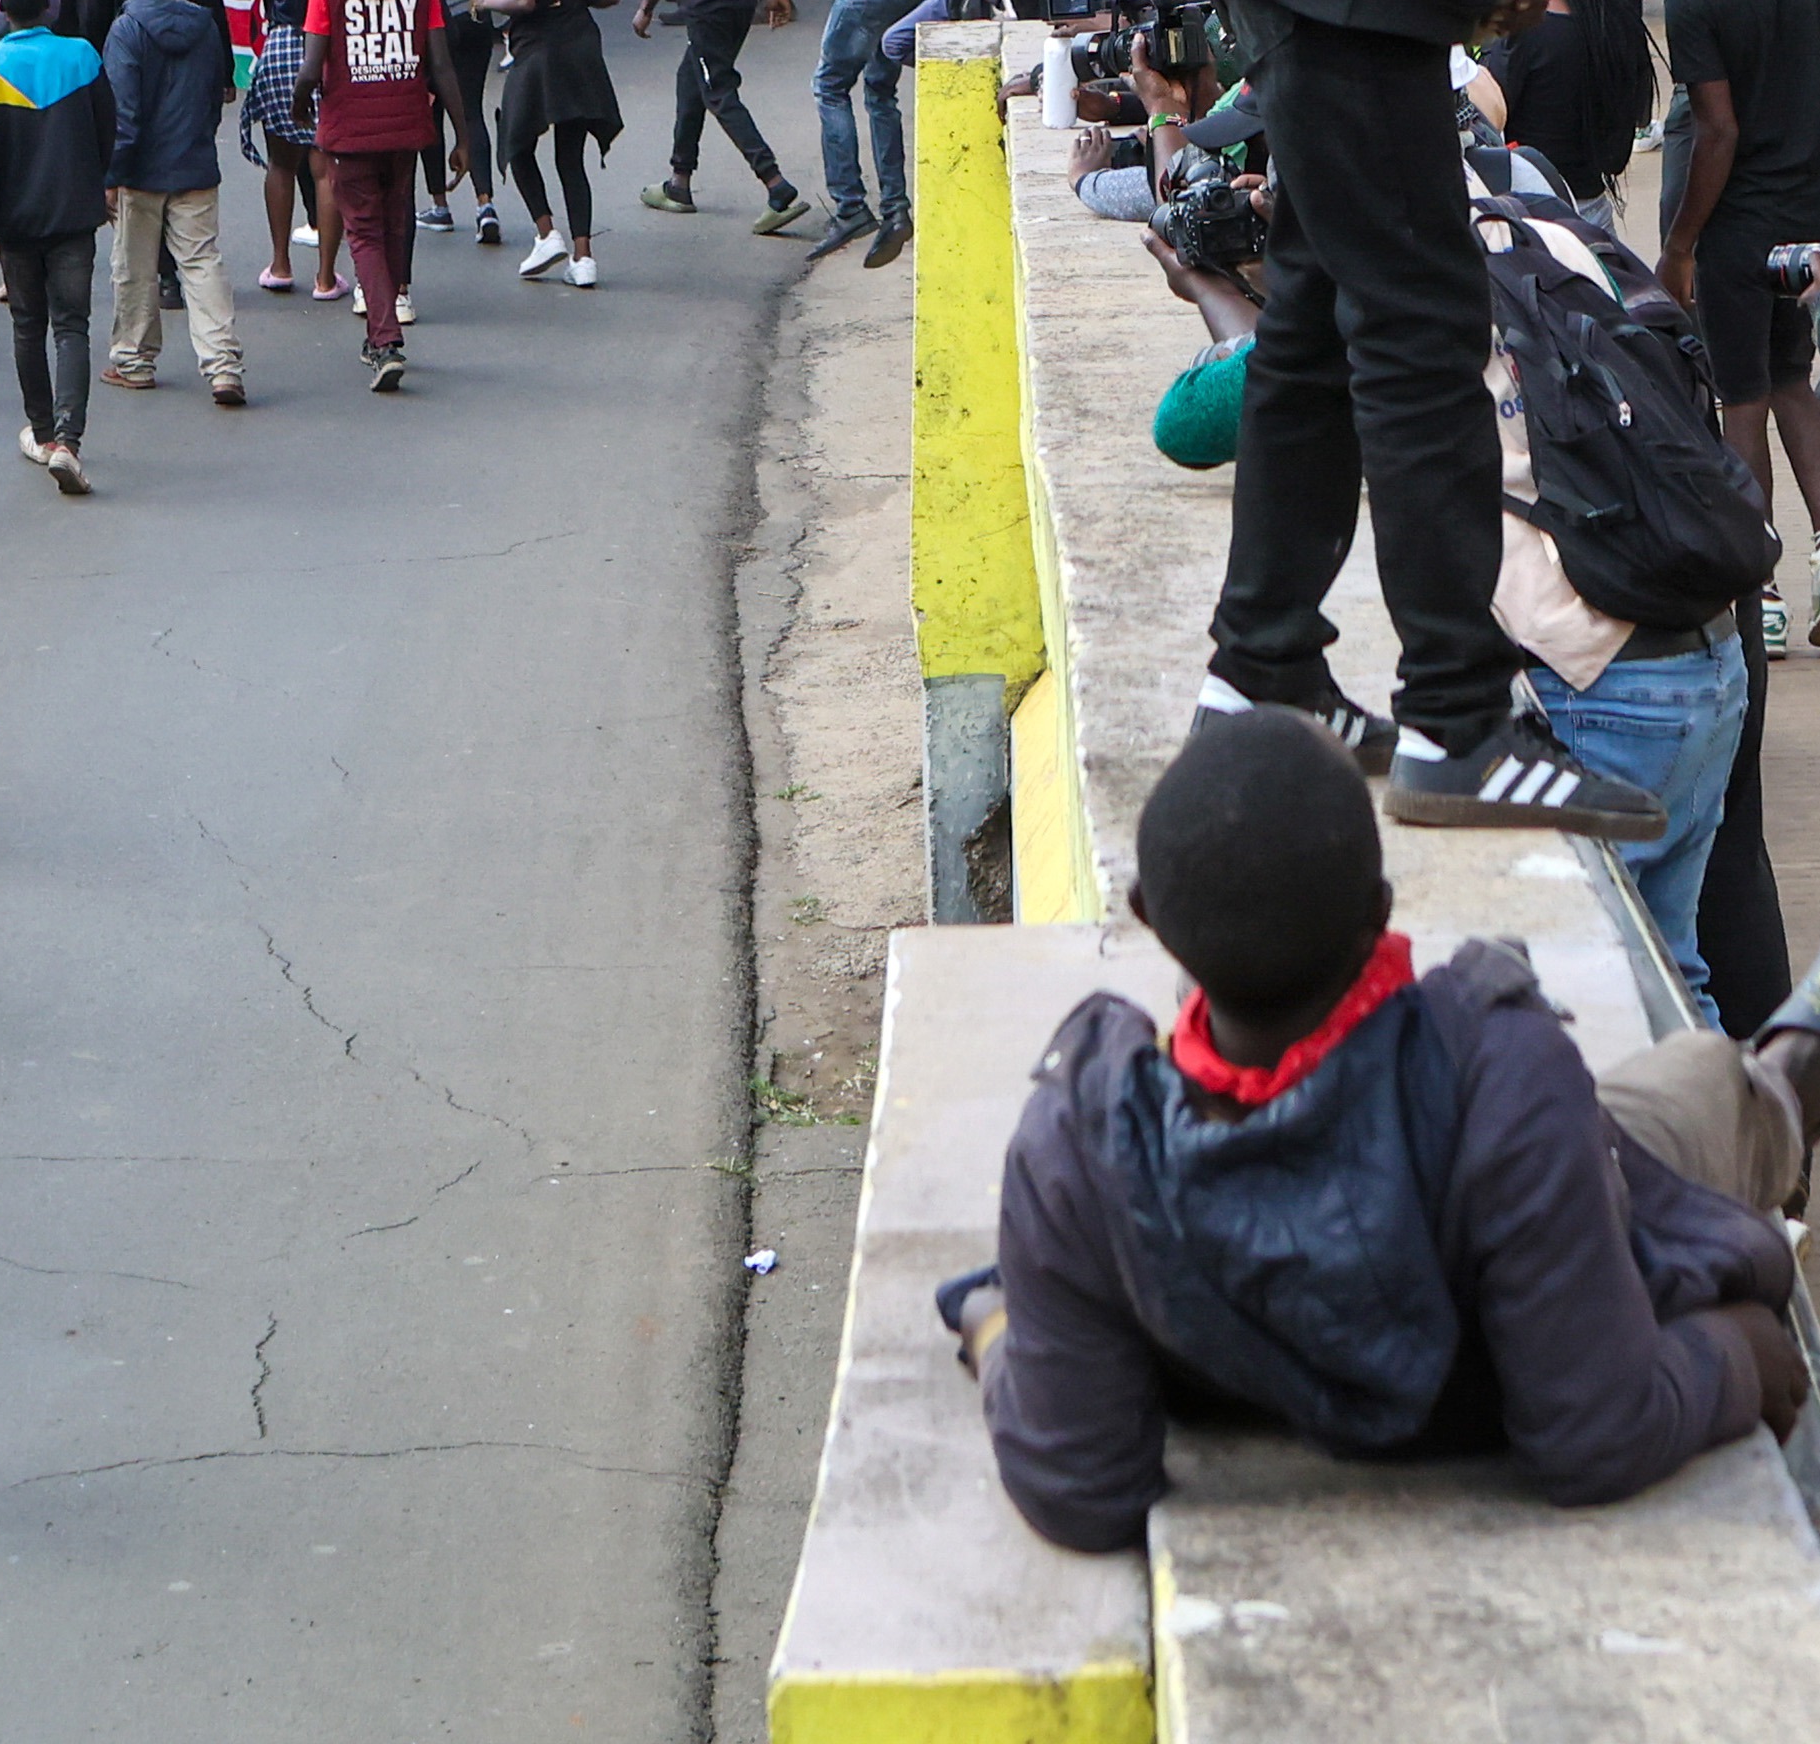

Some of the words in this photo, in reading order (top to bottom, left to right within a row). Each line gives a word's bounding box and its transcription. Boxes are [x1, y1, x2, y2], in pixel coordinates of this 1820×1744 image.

[346, 32, 420, 66] REAL
[351, 64, 401, 76] DESIGNED
[404, 62, 418, 72] BY
